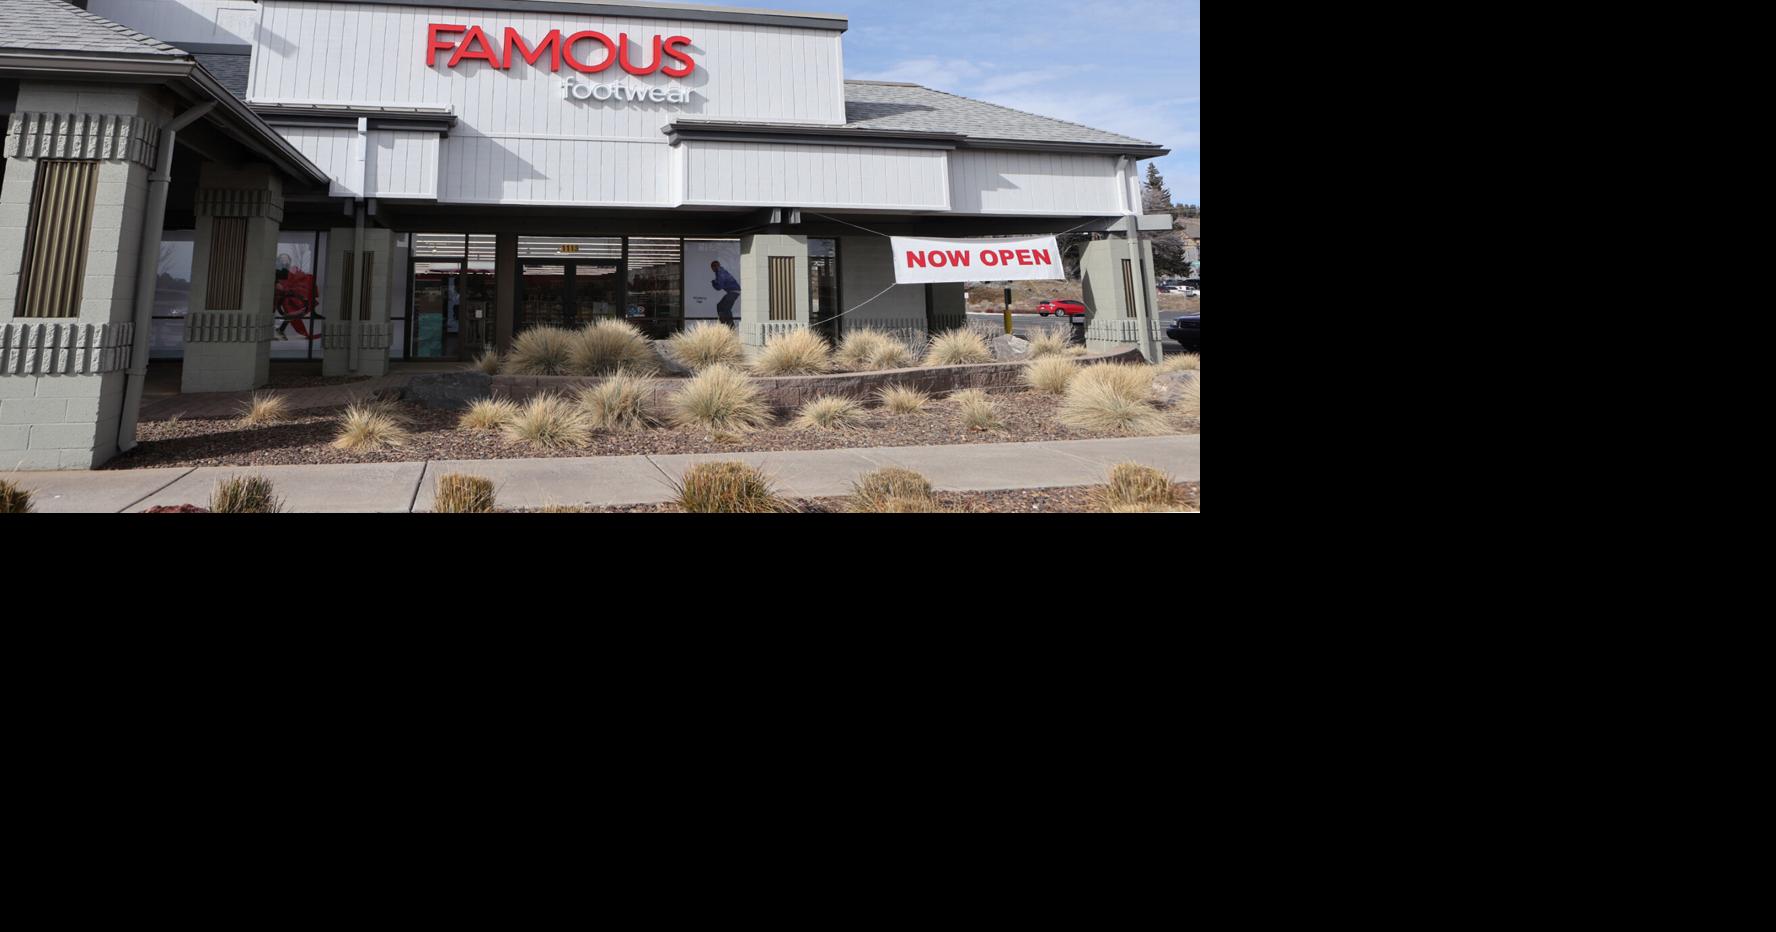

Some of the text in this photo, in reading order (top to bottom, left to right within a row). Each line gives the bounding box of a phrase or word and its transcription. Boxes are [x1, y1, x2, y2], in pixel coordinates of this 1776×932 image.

[426, 23, 696, 78] FAMOUS
[562, 76, 693, 104] footwear
[906, 249, 1052, 268] NOW OPEN
